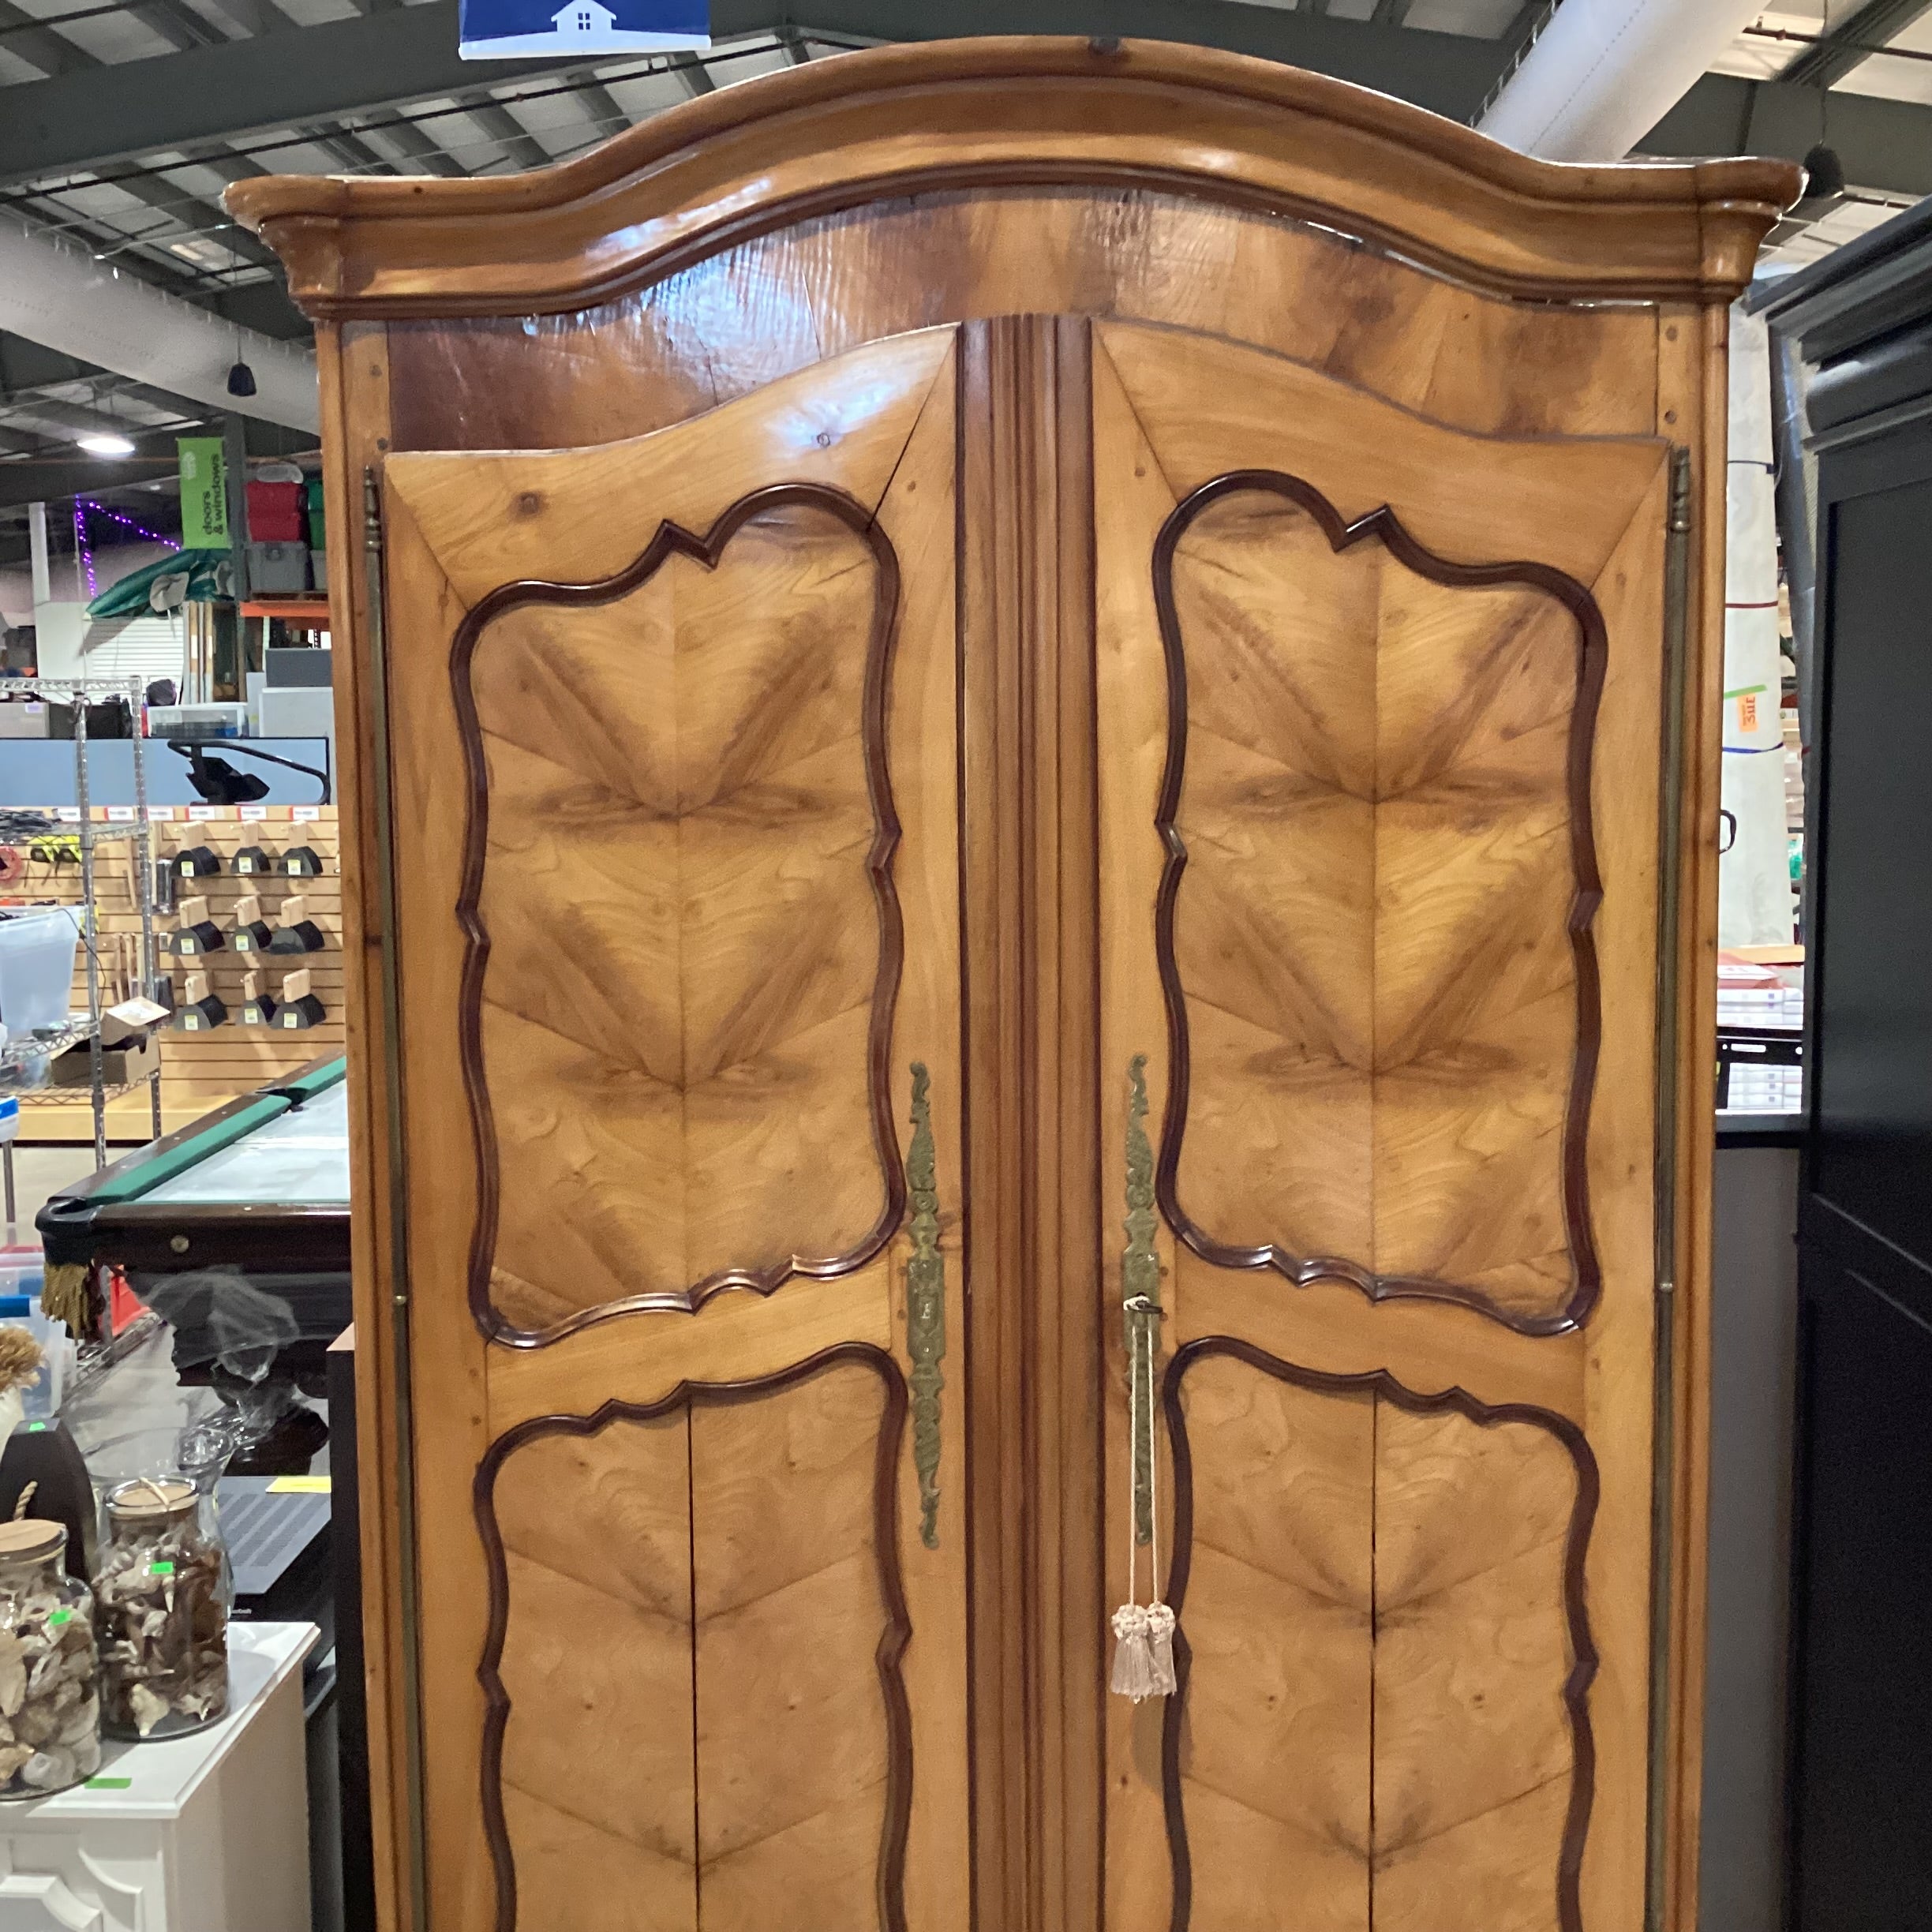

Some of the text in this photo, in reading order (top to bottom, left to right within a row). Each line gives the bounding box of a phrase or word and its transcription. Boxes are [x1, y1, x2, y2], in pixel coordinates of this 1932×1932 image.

[203, 491, 212, 535] doors
[211, 455, 223, 535] & windows
